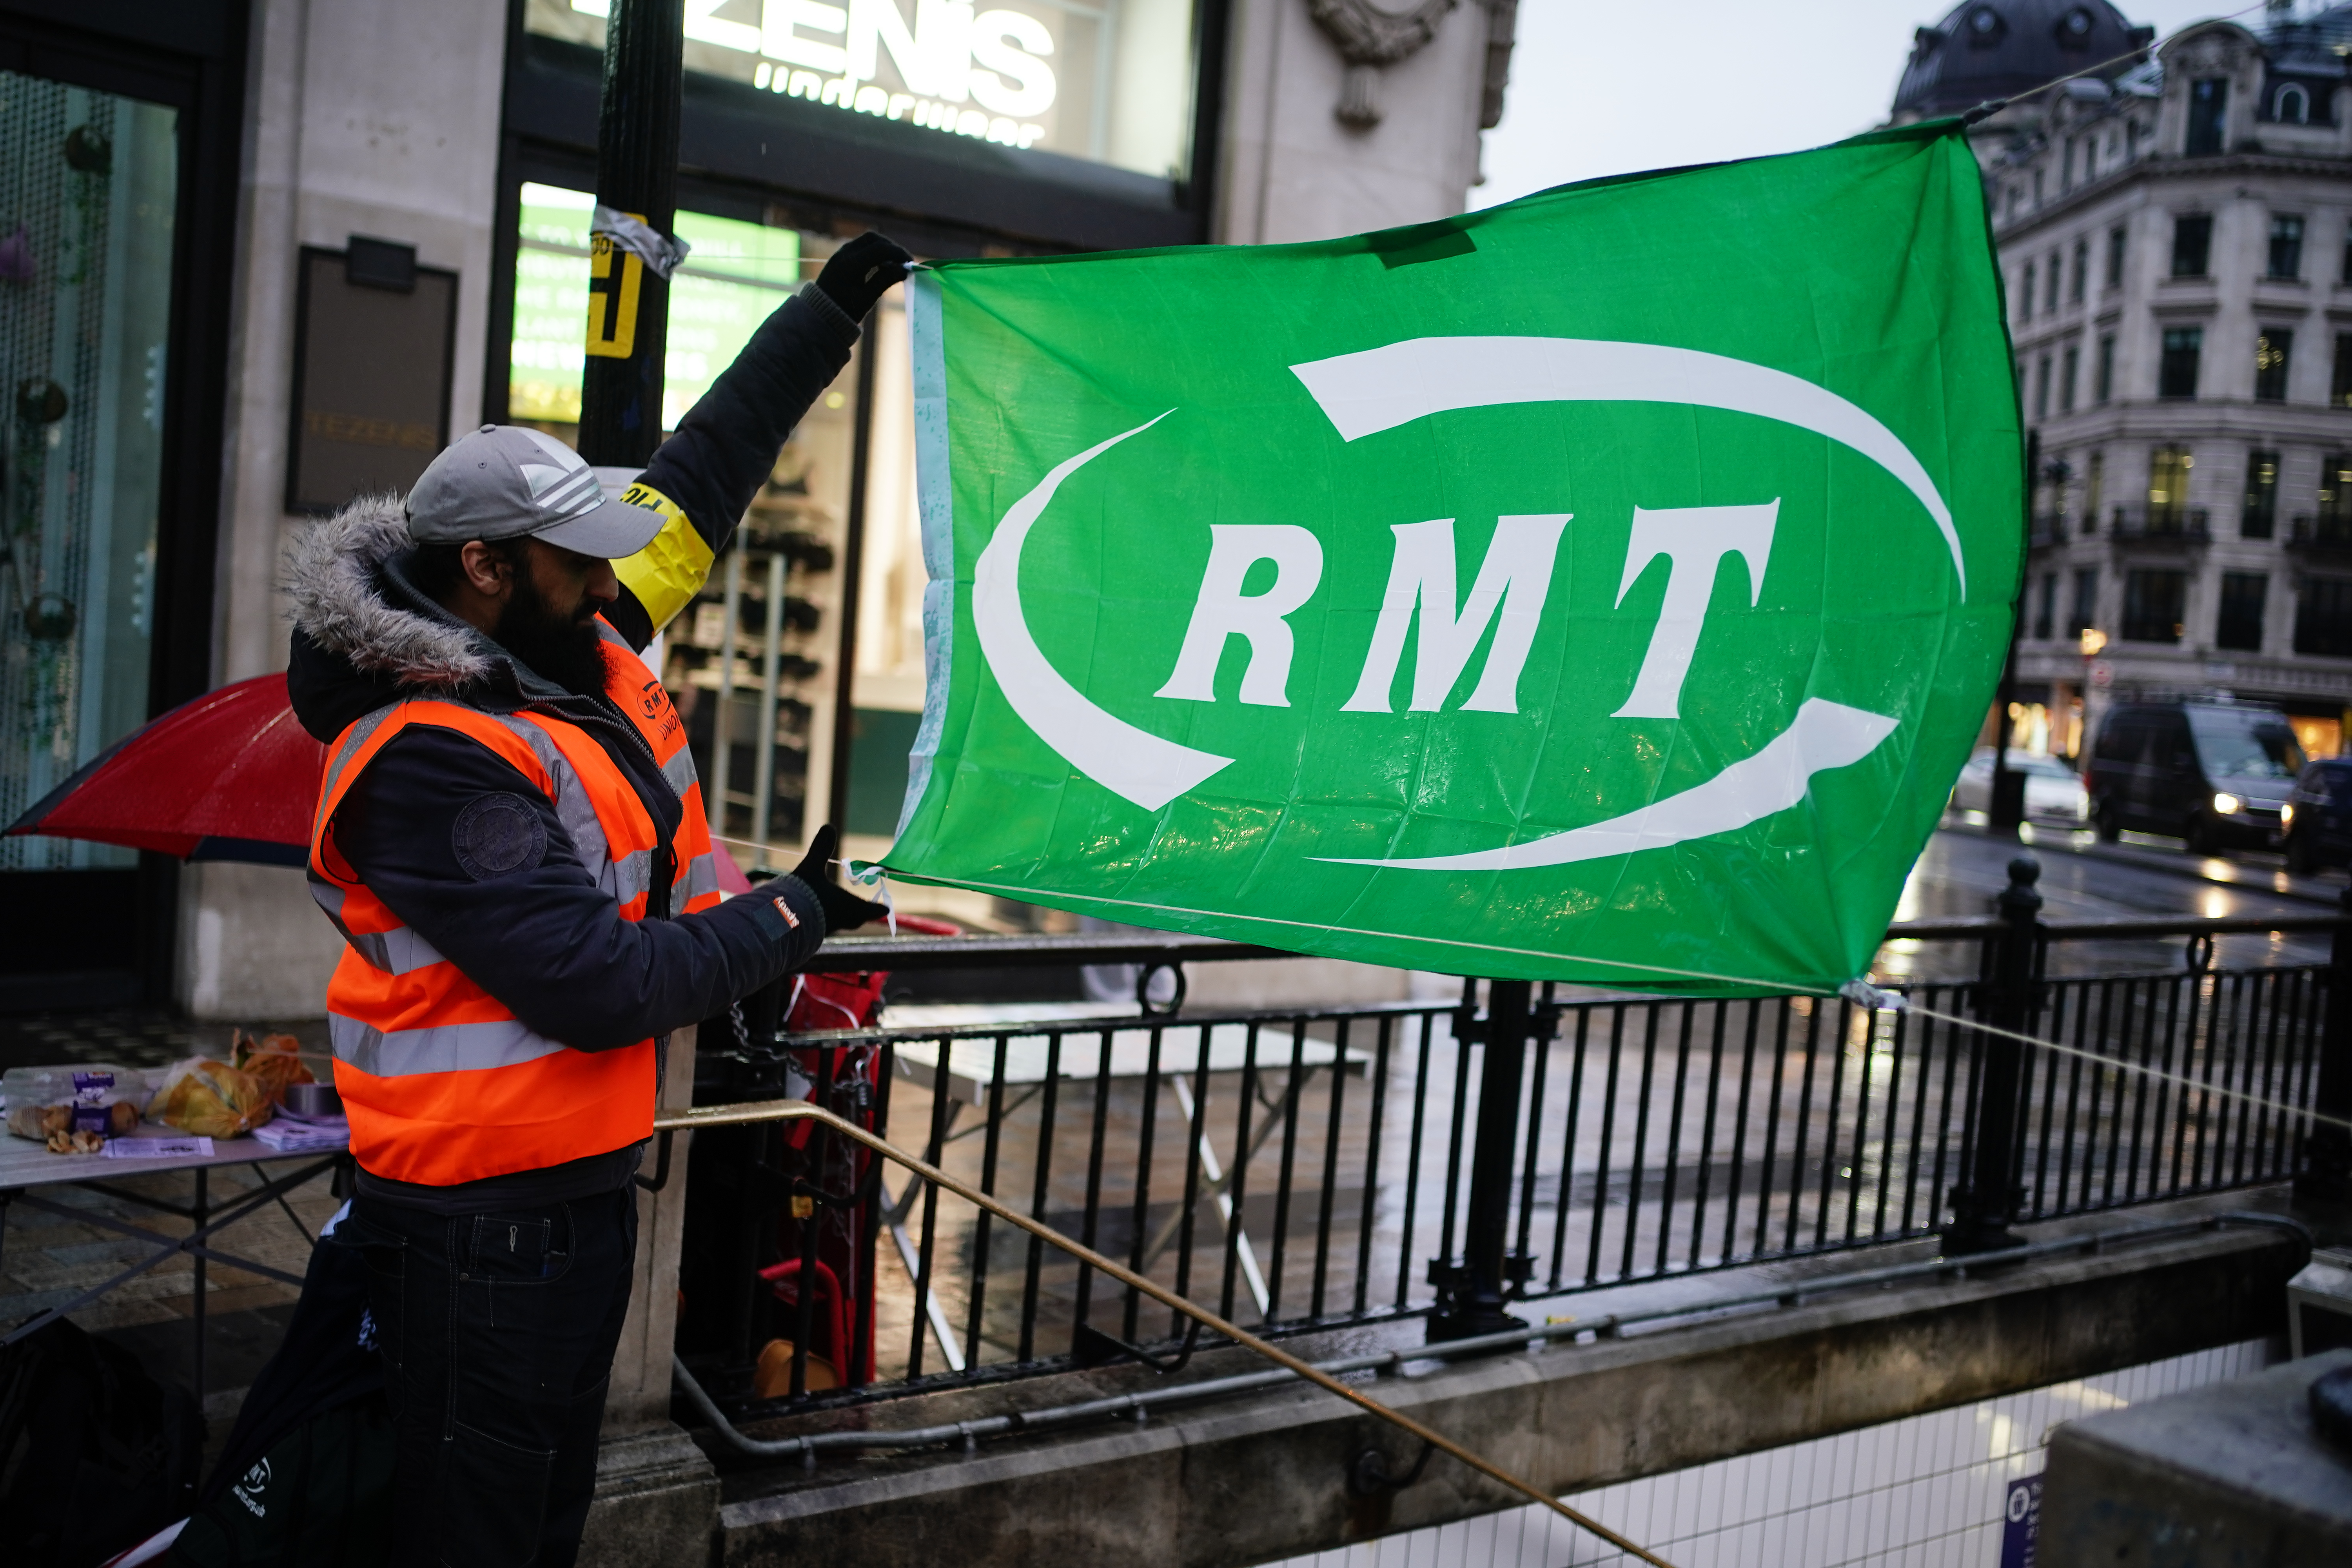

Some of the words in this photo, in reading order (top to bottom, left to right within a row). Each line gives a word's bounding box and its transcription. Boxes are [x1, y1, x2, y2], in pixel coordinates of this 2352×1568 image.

[570, 0, 1056, 117] ZENIS
[1154, 497, 1780, 719] RMT
[644, 686, 666, 713] RMT
